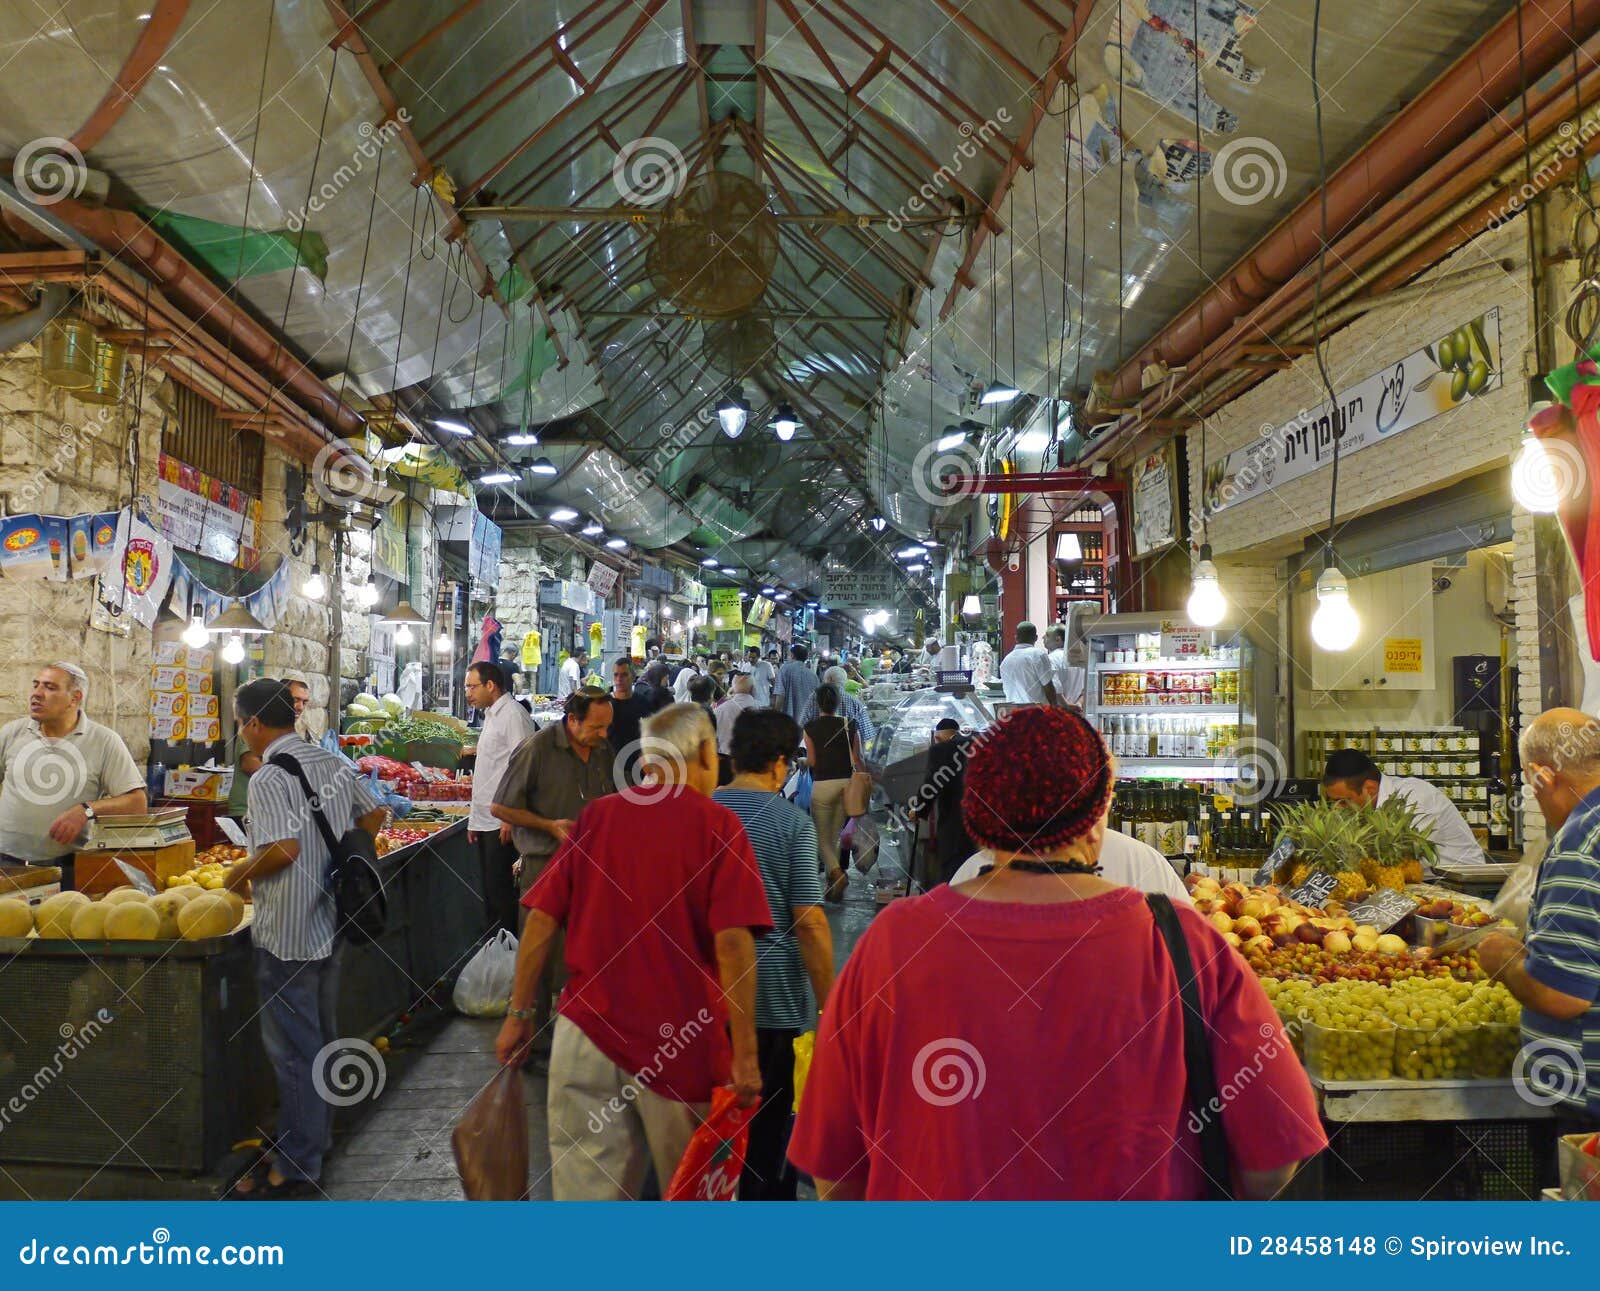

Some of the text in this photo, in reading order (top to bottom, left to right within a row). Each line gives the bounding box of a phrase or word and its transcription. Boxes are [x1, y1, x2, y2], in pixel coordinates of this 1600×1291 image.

[1349, 397, 1363, 423] רק
[1284, 426, 1308, 464] זית
[1312, 406, 1347, 462] שמן
[826, 574, 858, 582] לרחוב
[828, 583, 887, 591] מחנה יהודה
